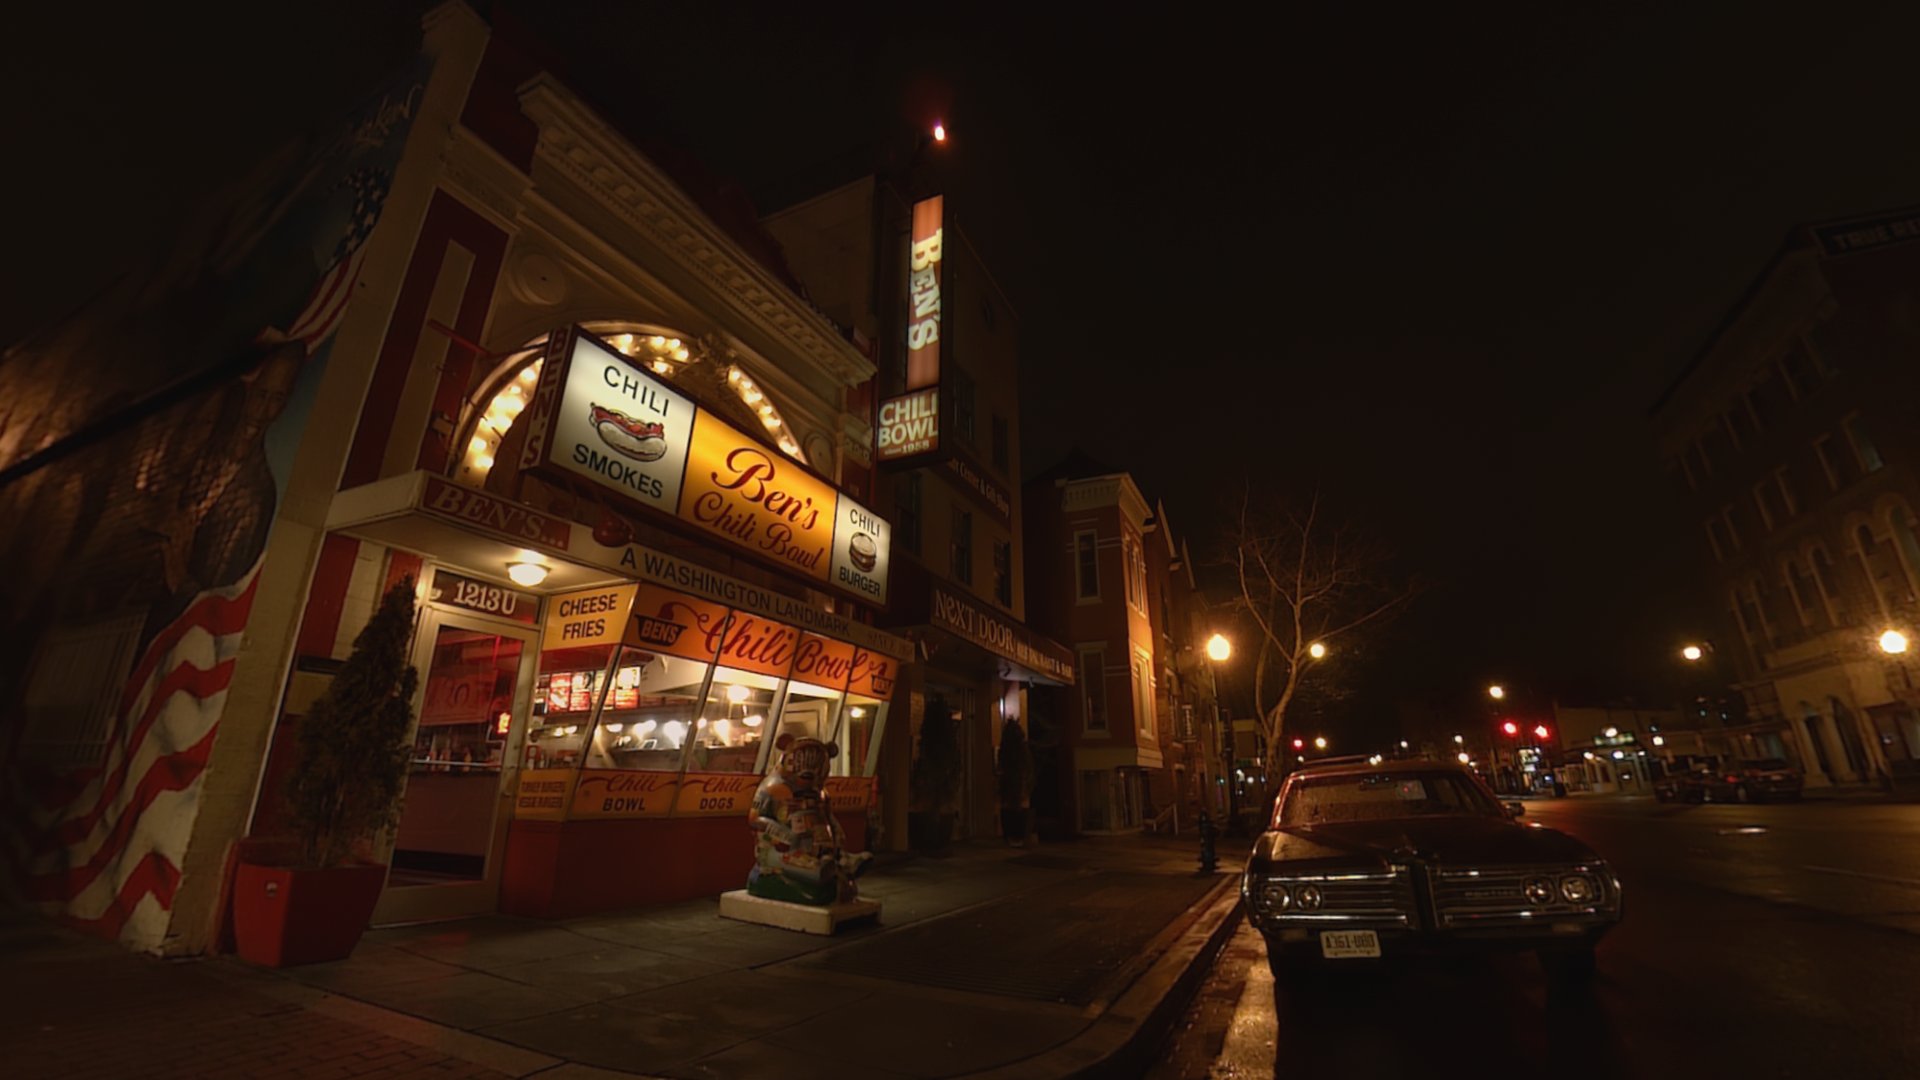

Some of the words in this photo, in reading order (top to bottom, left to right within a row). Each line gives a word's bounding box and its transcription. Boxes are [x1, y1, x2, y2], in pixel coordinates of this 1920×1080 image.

[908, 228, 943, 351] BEN'S
[523, 328, 570, 466] BEN'S
[603, 365, 670, 417] CHILI
[879, 392, 938, 427] CHILI
[878, 416, 939, 448] BOWL
[572, 443, 664, 499] SMOKES
[711, 447, 819, 530] Ben's
[693, 491, 757, 543] Chili
[758, 522, 825, 571] Bowl
[849, 508, 882, 538] CHILI
[620, 547, 637, 570] A
[644, 552, 770, 611] WASHINGTON
[775, 598, 850, 637] LANDMARK
[839, 565, 882, 598] BURGER
[559, 593, 618, 618] CHEESE
[562, 619, 605, 641] FRIES
[979, 612, 1015, 654] DOOR
[702, 614, 794, 666] Chili
[795, 639, 870, 684] Bowl
[605, 773, 660, 793] Chili
[702, 776, 745, 793] Chili
[602, 797, 646, 812] BOWL
[699, 797, 735, 811] DOGS
